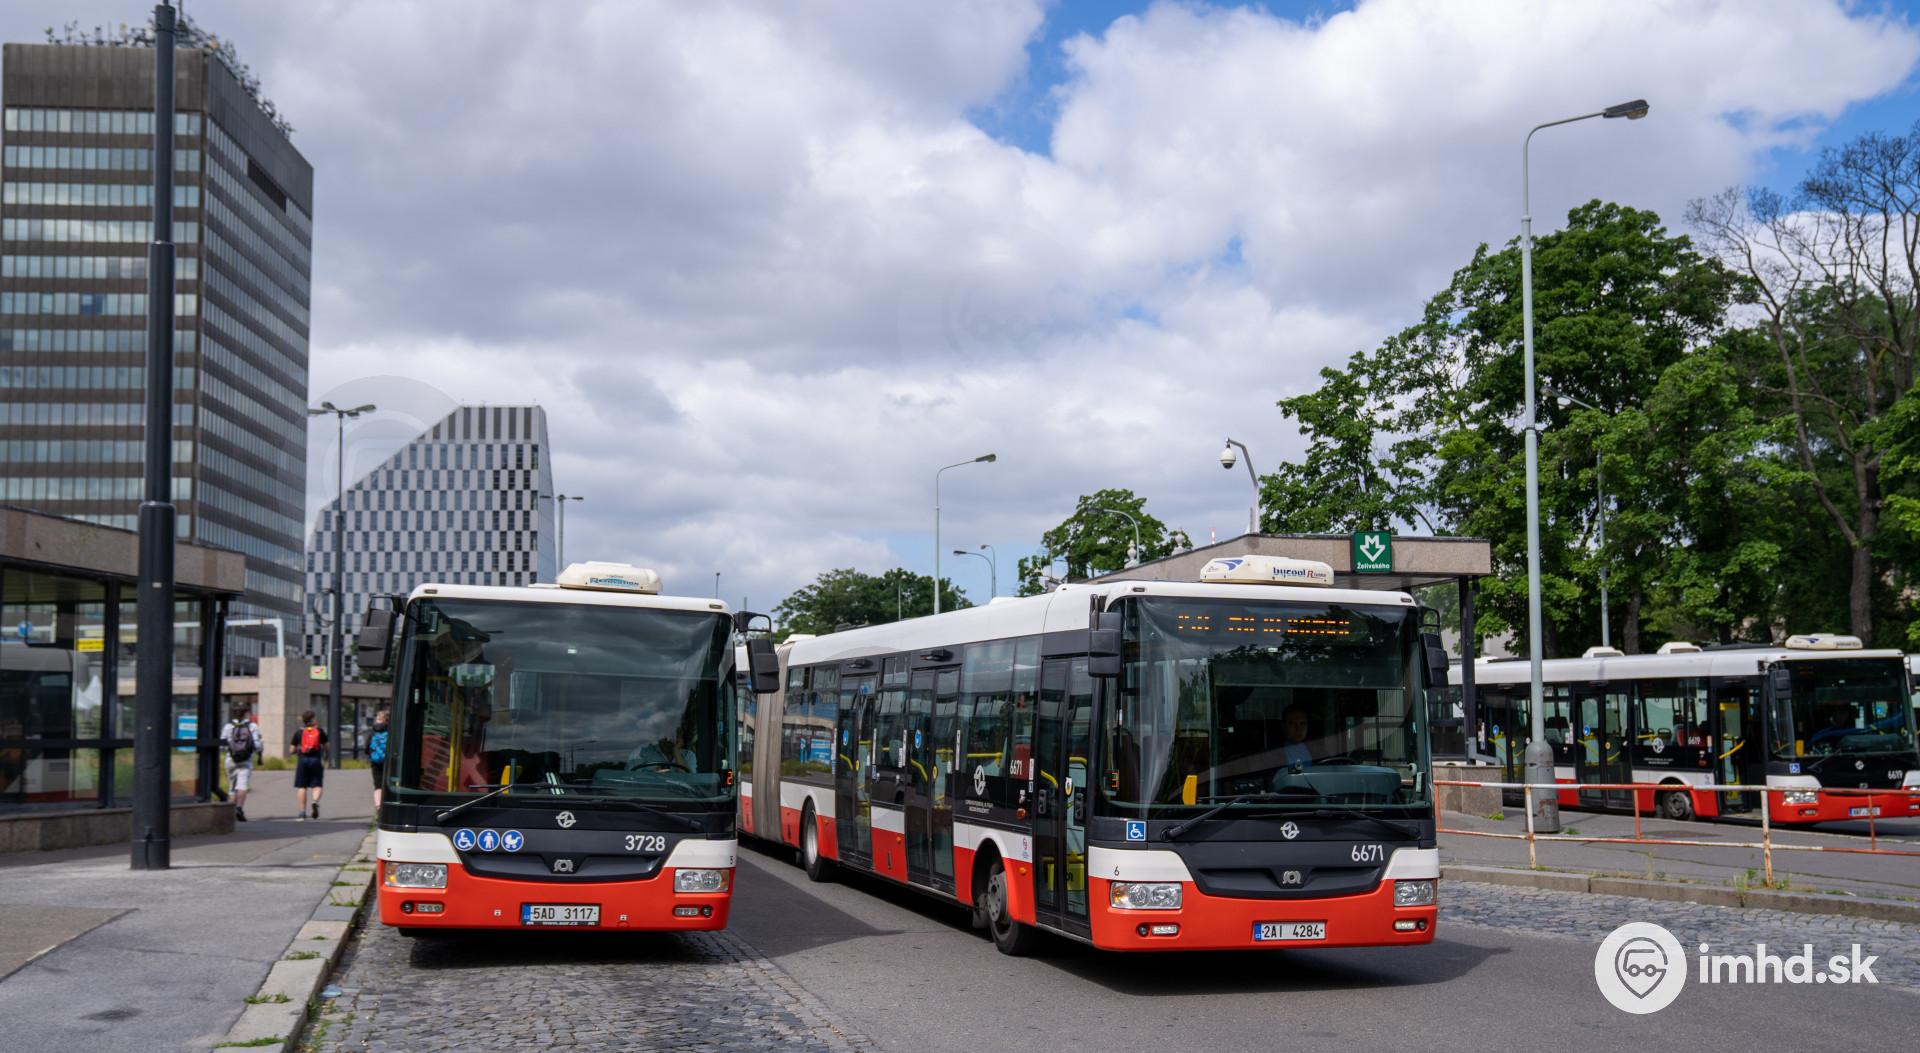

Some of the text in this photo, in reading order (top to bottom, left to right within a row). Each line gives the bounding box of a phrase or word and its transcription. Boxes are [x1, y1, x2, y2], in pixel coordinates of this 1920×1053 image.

[1357, 561, 1390, 570] Želivského
[1010, 759, 1023, 775] 6671
[625, 835, 666, 852] 3728
[386, 848, 392, 858] 5
[1351, 844, 1384, 862] 6671
[1113, 866, 1120, 877] 6
[533, 907, 593, 920] 5AD 3117
[1264, 924, 1320, 938] 2AI 4284
